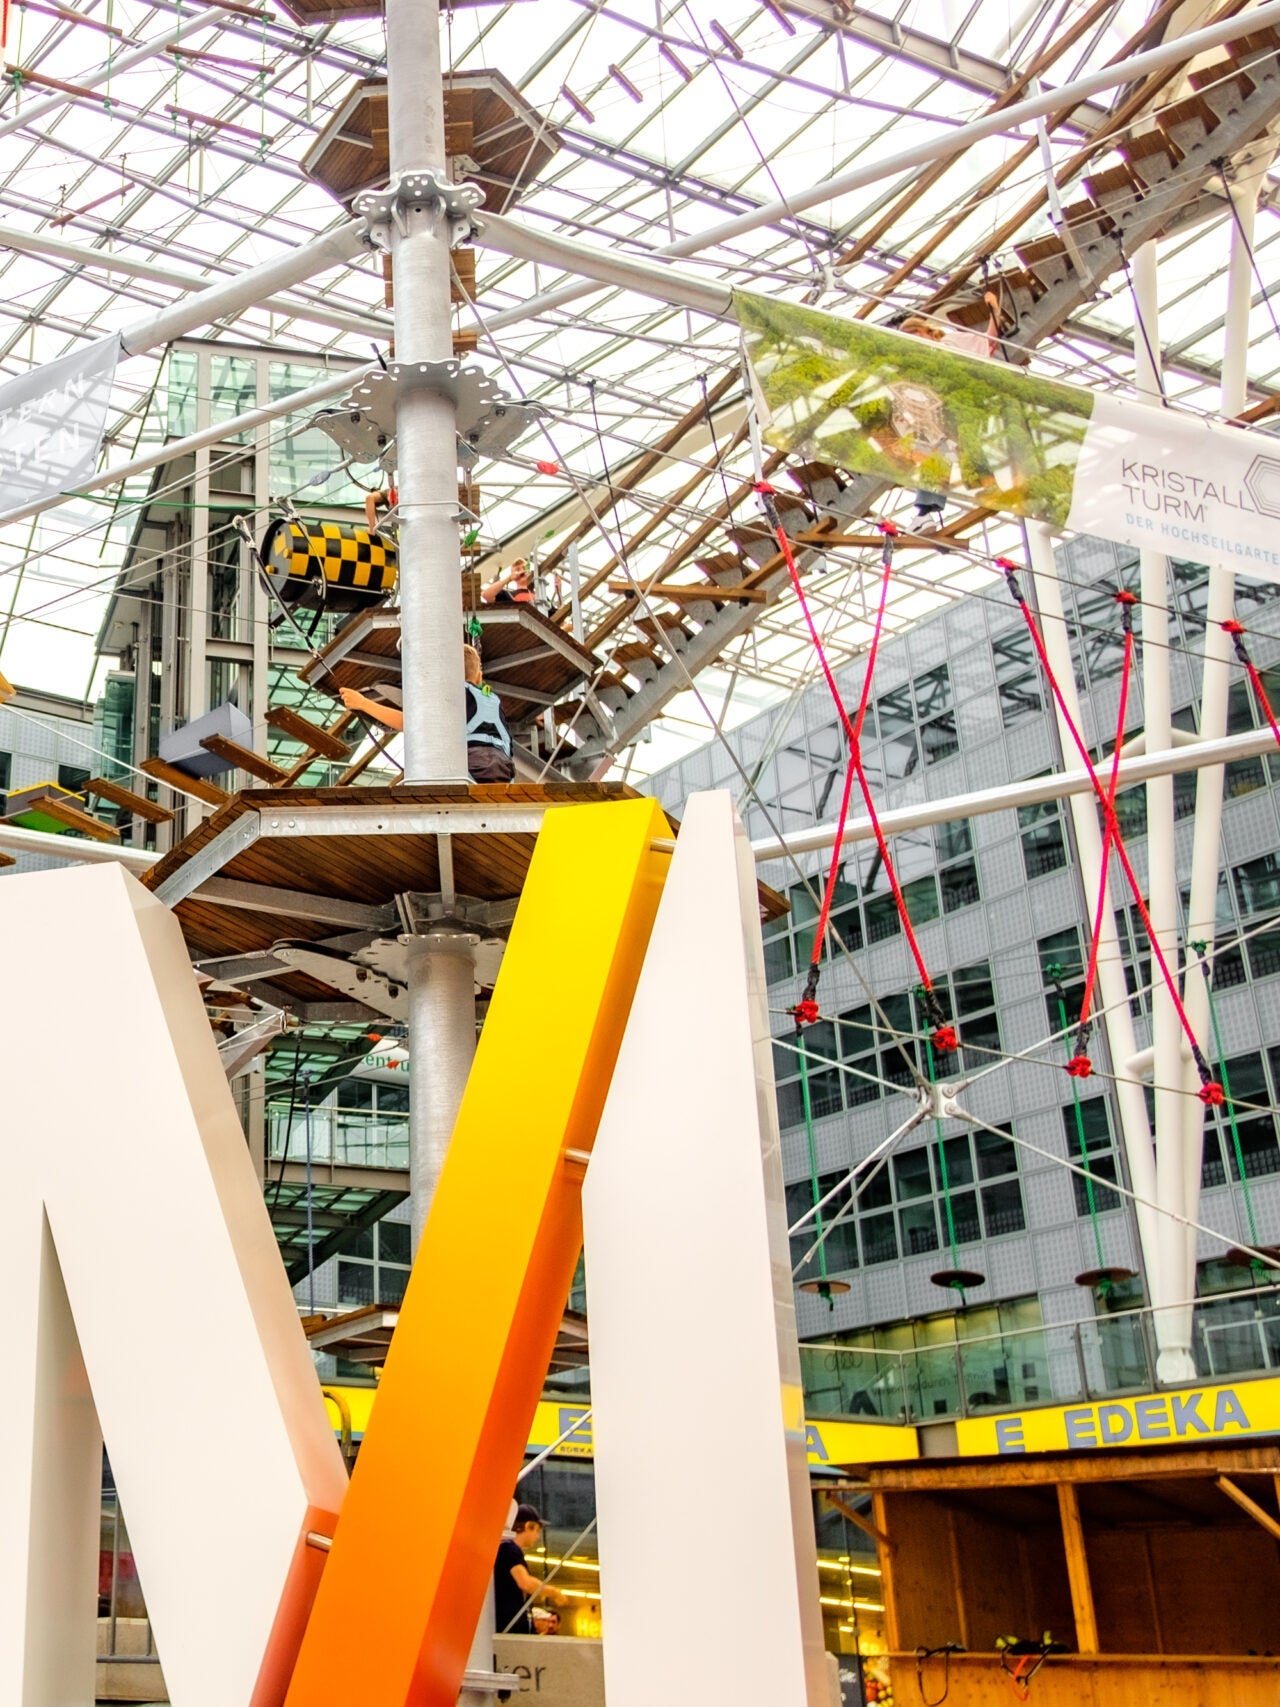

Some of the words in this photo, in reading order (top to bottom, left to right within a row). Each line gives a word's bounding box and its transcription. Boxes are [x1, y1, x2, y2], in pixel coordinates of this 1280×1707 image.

[1122, 457, 1256, 513] KRISTALL
[1125, 512, 1154, 531] DER
[994, 1416, 1026, 1454] E
[1063, 1389, 1251, 1449] EDEKA
